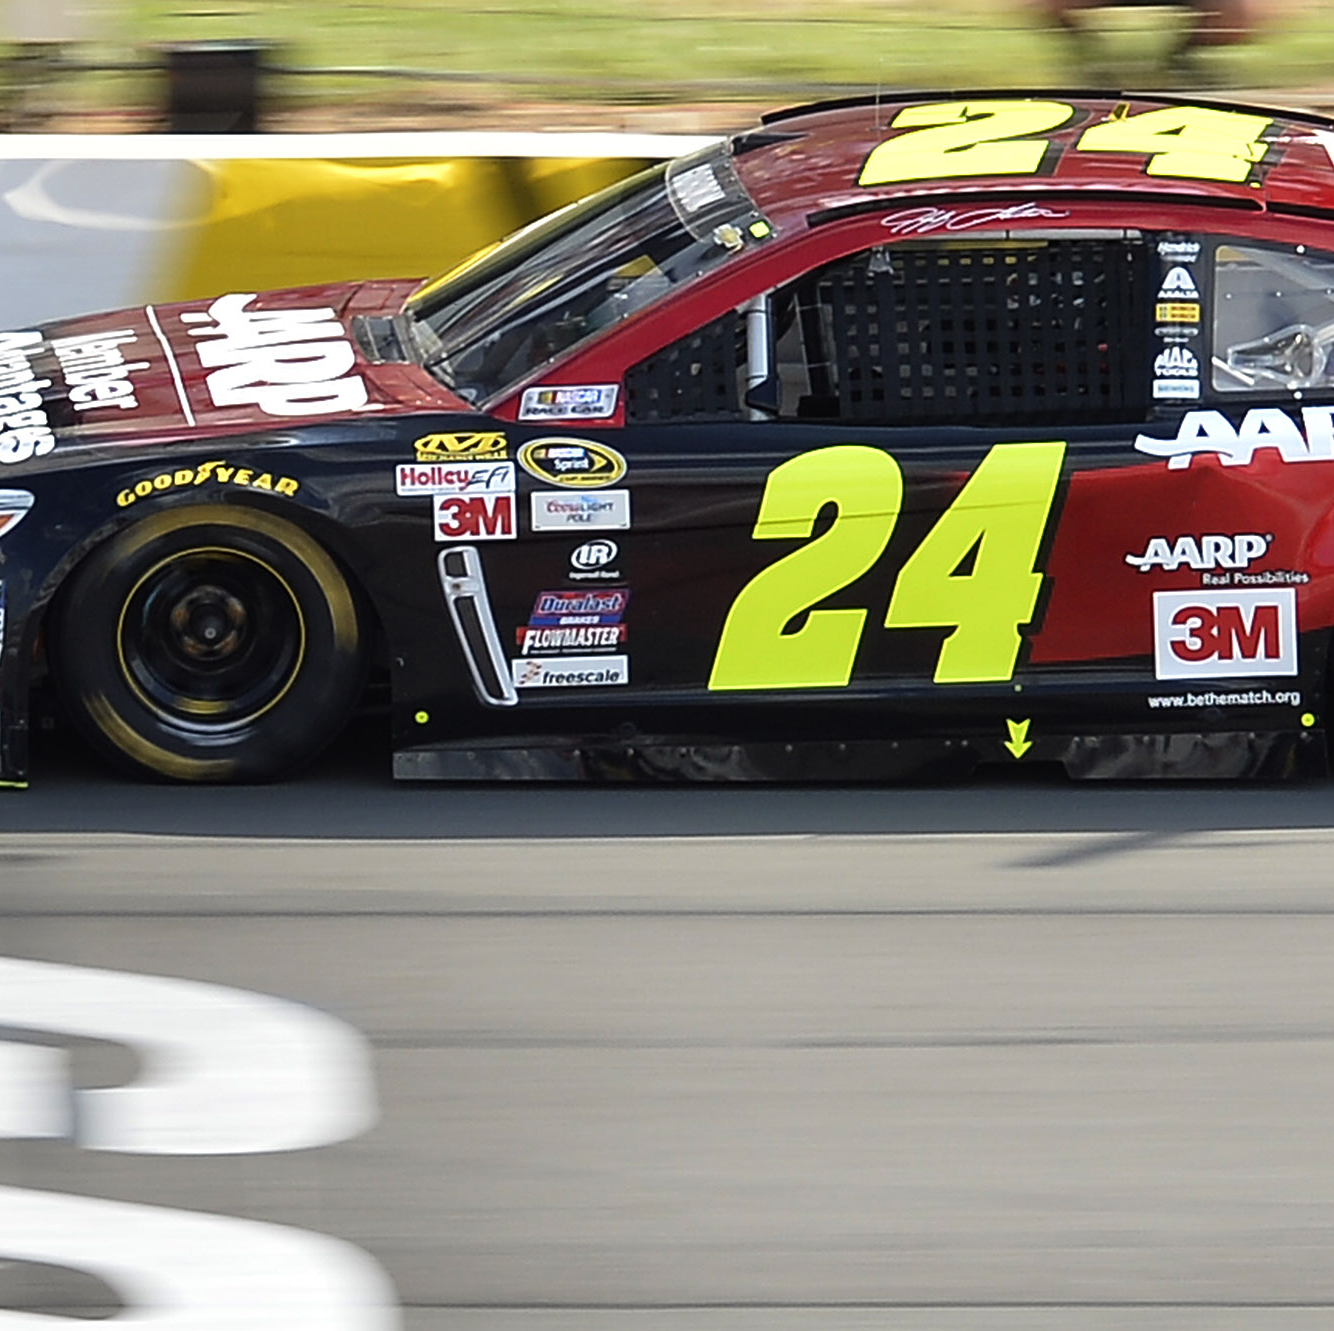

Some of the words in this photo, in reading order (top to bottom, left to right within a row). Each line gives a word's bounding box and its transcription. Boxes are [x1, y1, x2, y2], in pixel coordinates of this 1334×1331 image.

[859, 100, 1274, 186] 24
[116, 460, 300, 508] GOODYEAR
[400, 466, 469, 492] Holley
[438, 496, 513, 537] 3M
[708, 441, 1067, 691] 24
[1124, 535, 1268, 572] AARP
[1202, 573, 1231, 586] Real
[1233, 571, 1310, 585] Possibilities
[538, 592, 623, 614] Duralast
[521, 627, 620, 656] FLOWMASTER
[1169, 605, 1281, 662] 3M
[542, 669, 620, 685] freescale
[1147, 689, 1301, 708] www.bethematch.org
